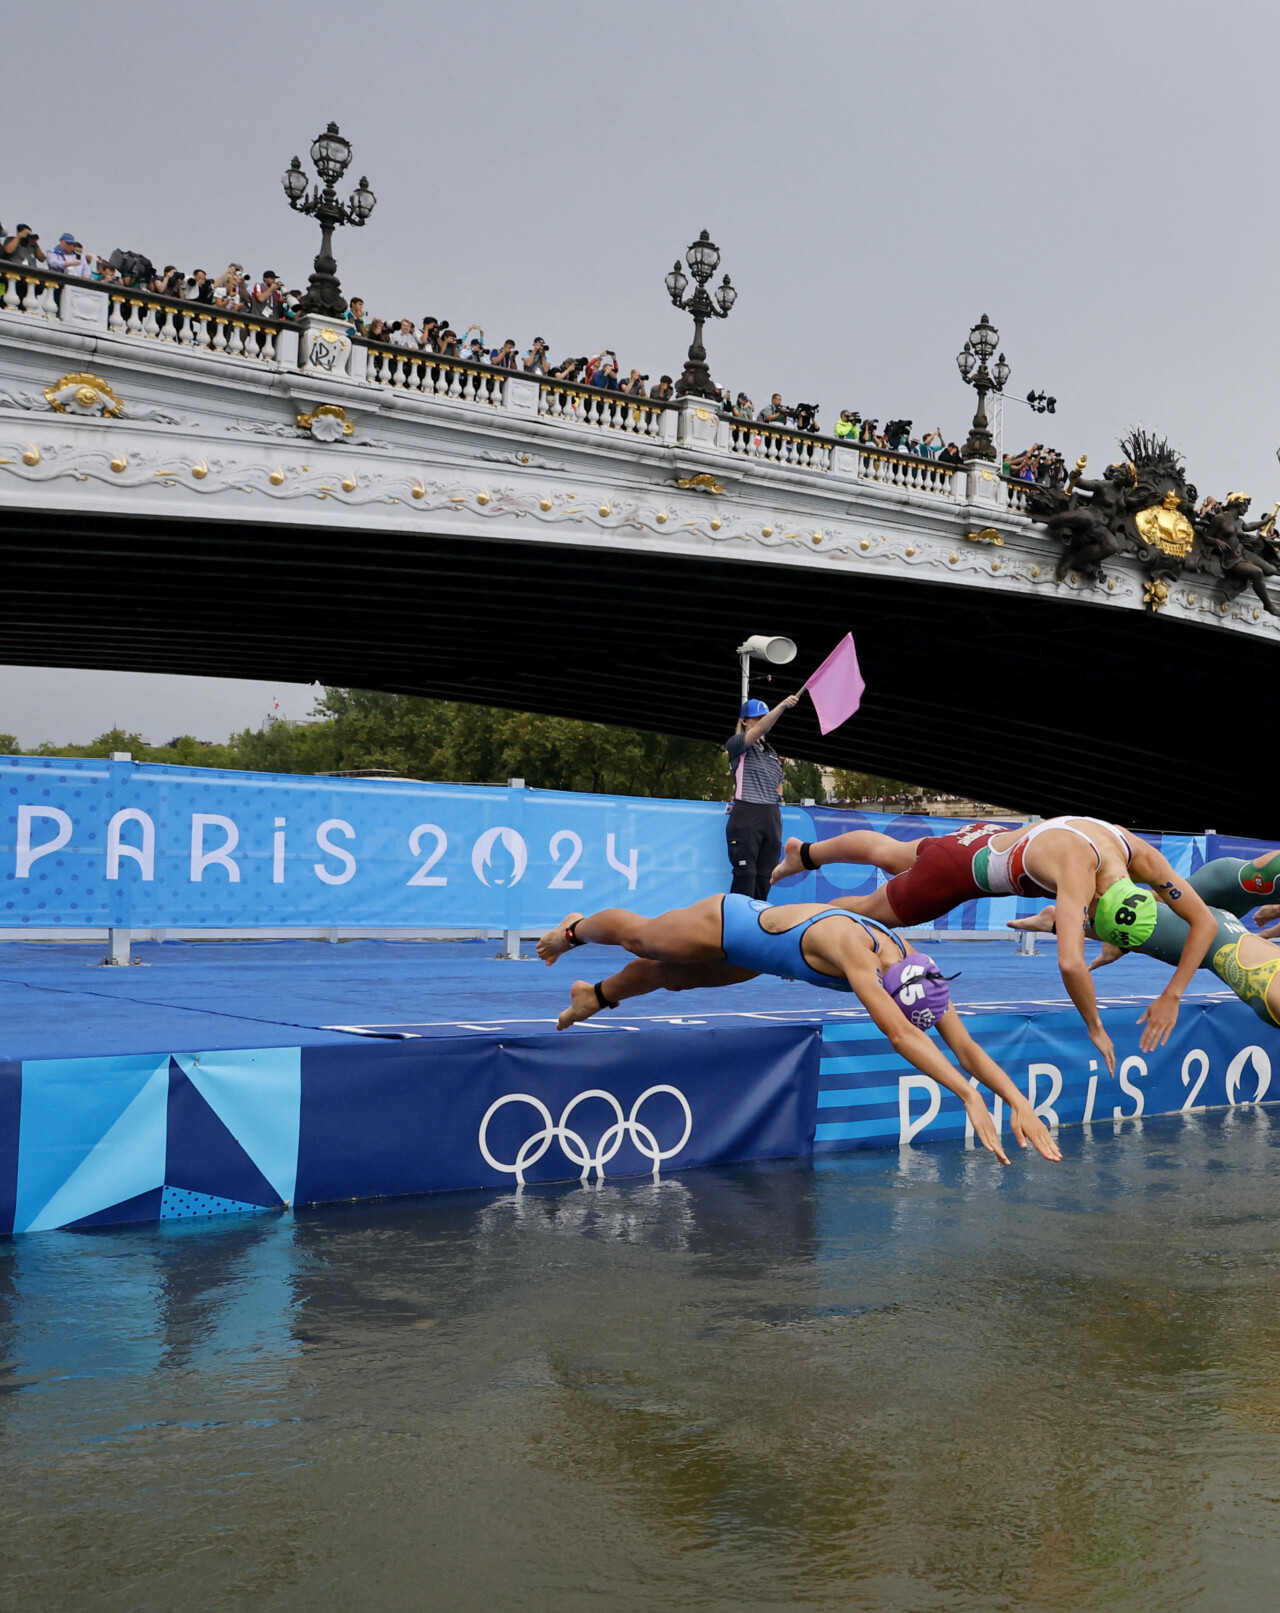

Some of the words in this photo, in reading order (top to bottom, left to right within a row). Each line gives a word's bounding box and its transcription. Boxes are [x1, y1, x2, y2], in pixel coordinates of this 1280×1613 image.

[406, 823, 640, 890] 2024
[1115, 894, 1147, 926] 48
[900, 964, 926, 1006] 55
